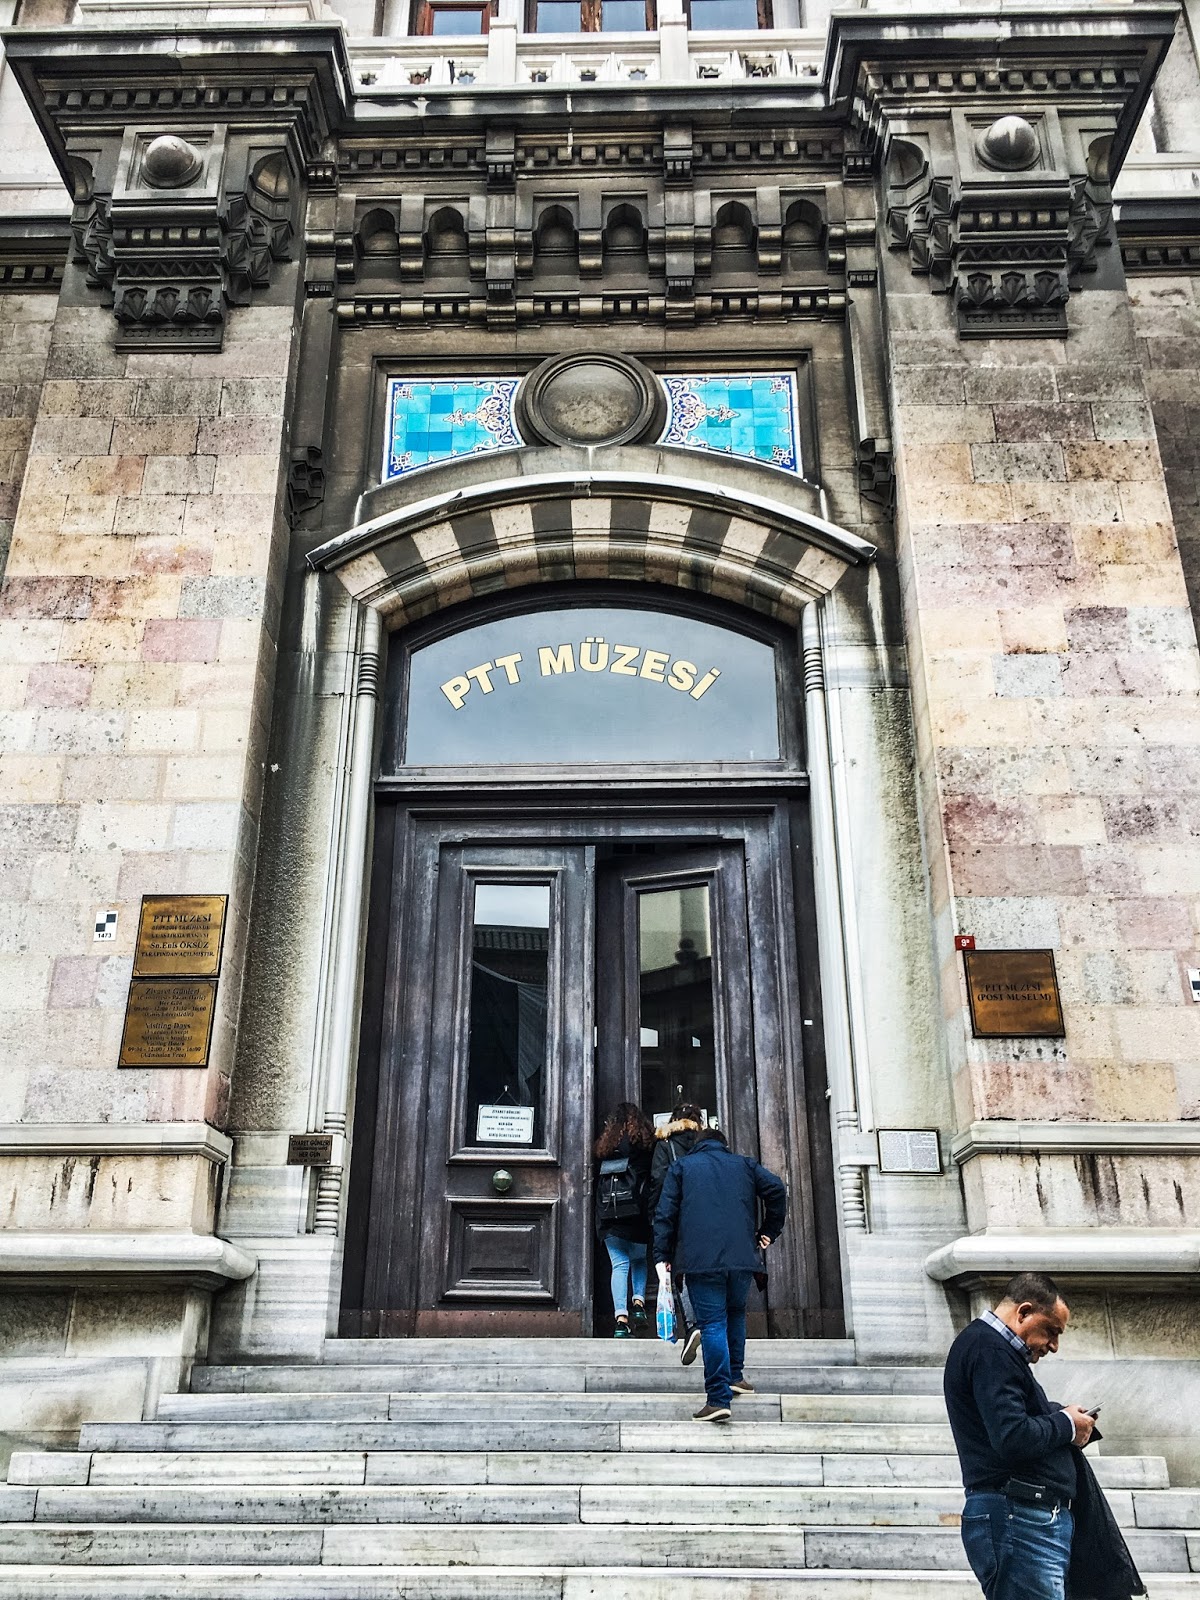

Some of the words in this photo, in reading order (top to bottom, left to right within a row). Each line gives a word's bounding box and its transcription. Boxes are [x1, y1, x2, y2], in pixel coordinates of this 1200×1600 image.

[440, 652, 523, 711] PTT
[537, 636, 722, 701] MÜZESİ
[153, 914, 172, 923] PTT
[179, 941, 209, 949] ÖKSÜZ
[977, 993, 1003, 1002] (POST
[1007, 993, 1052, 1002] MUSEUM)
